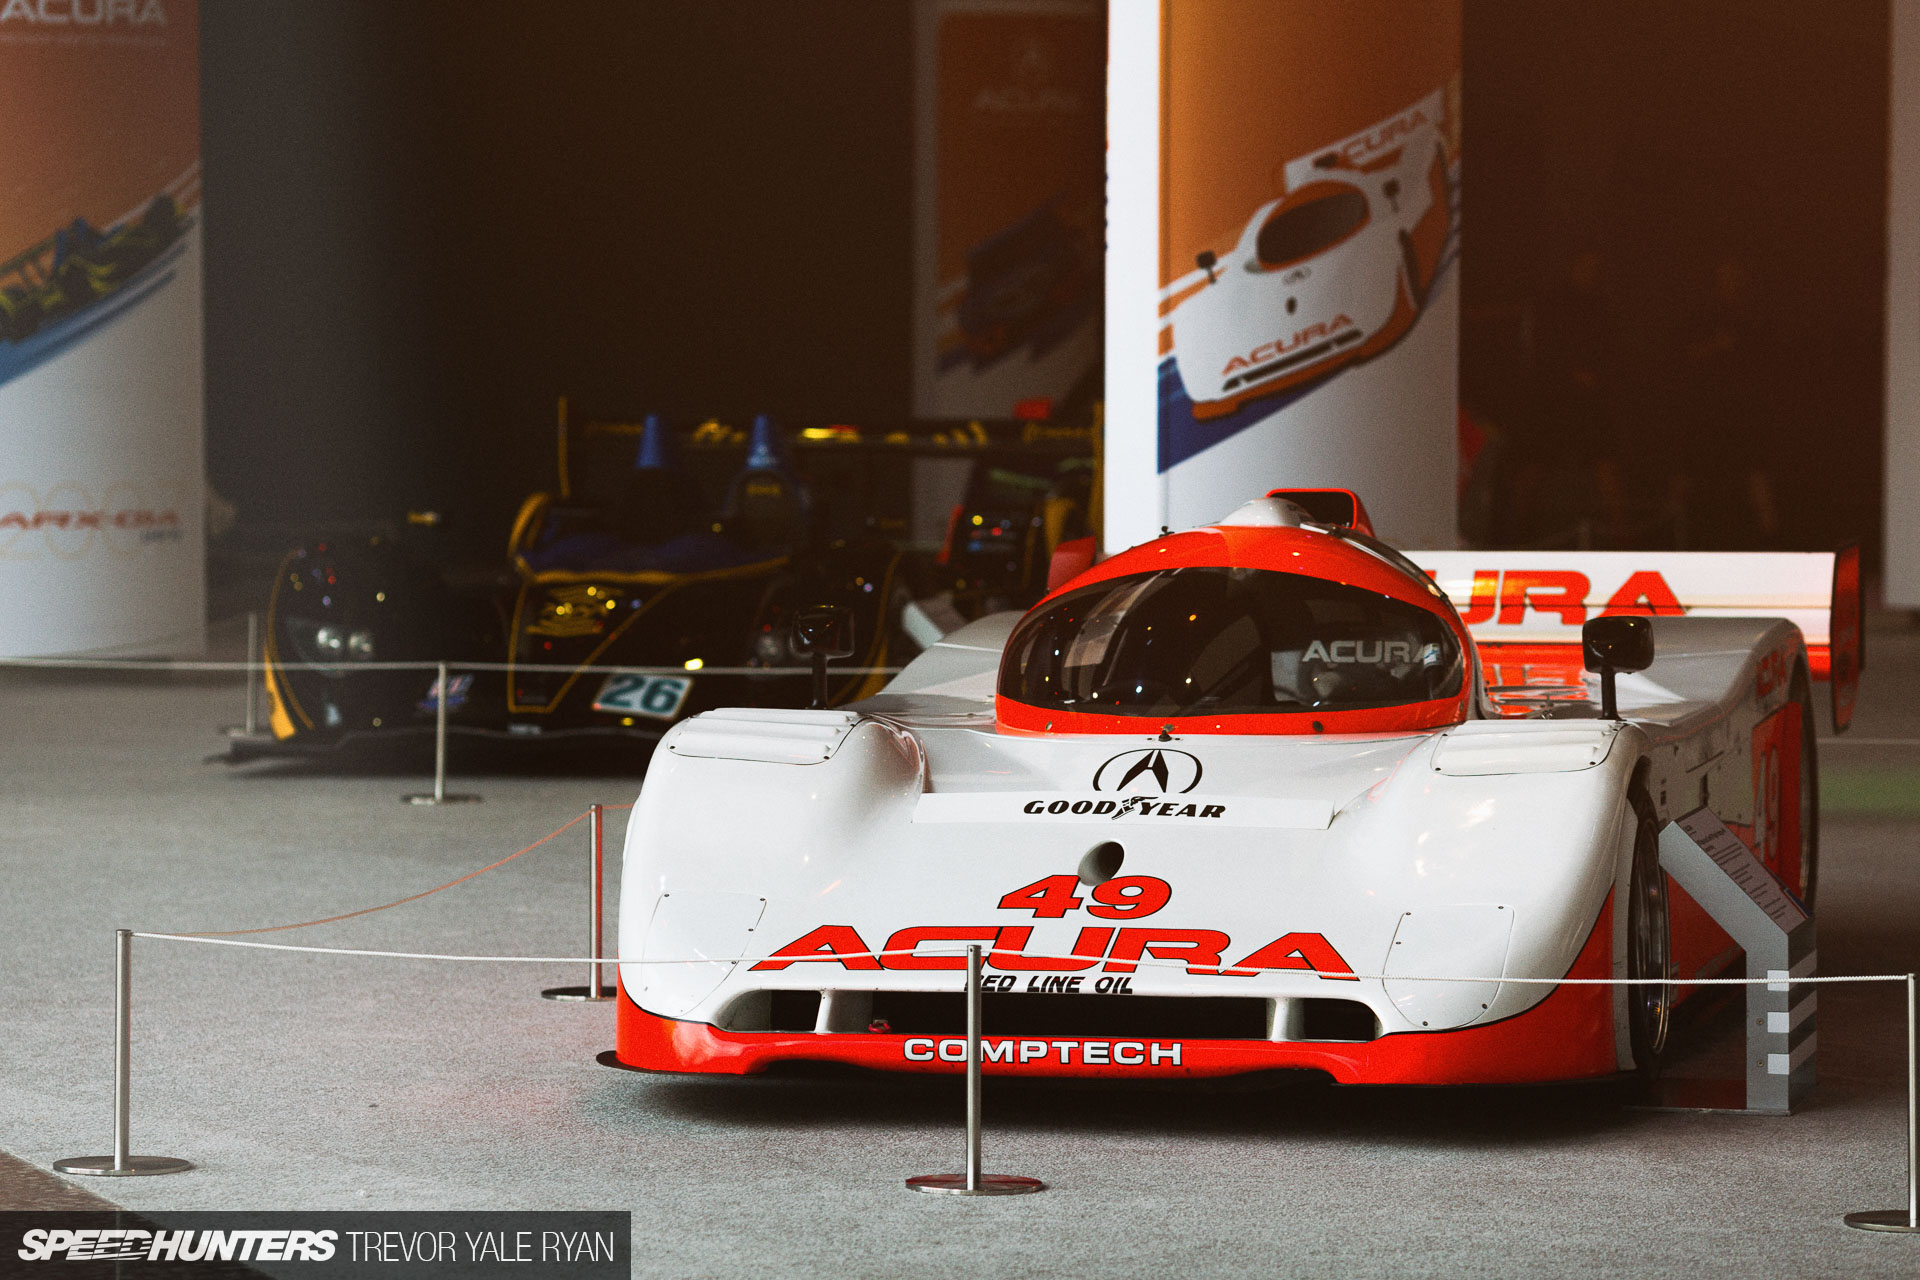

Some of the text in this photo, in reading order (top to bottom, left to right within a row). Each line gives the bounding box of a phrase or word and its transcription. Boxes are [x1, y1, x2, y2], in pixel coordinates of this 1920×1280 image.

[1222, 313, 1353, 376] ACURA
[601, 674, 683, 713] 26
[996, 874, 1173, 920] 49
[747, 924, 1362, 982] ACURA
[964, 975, 1133, 994] ED LINE OIL
[903, 1038, 1183, 1066] COMPTECH
